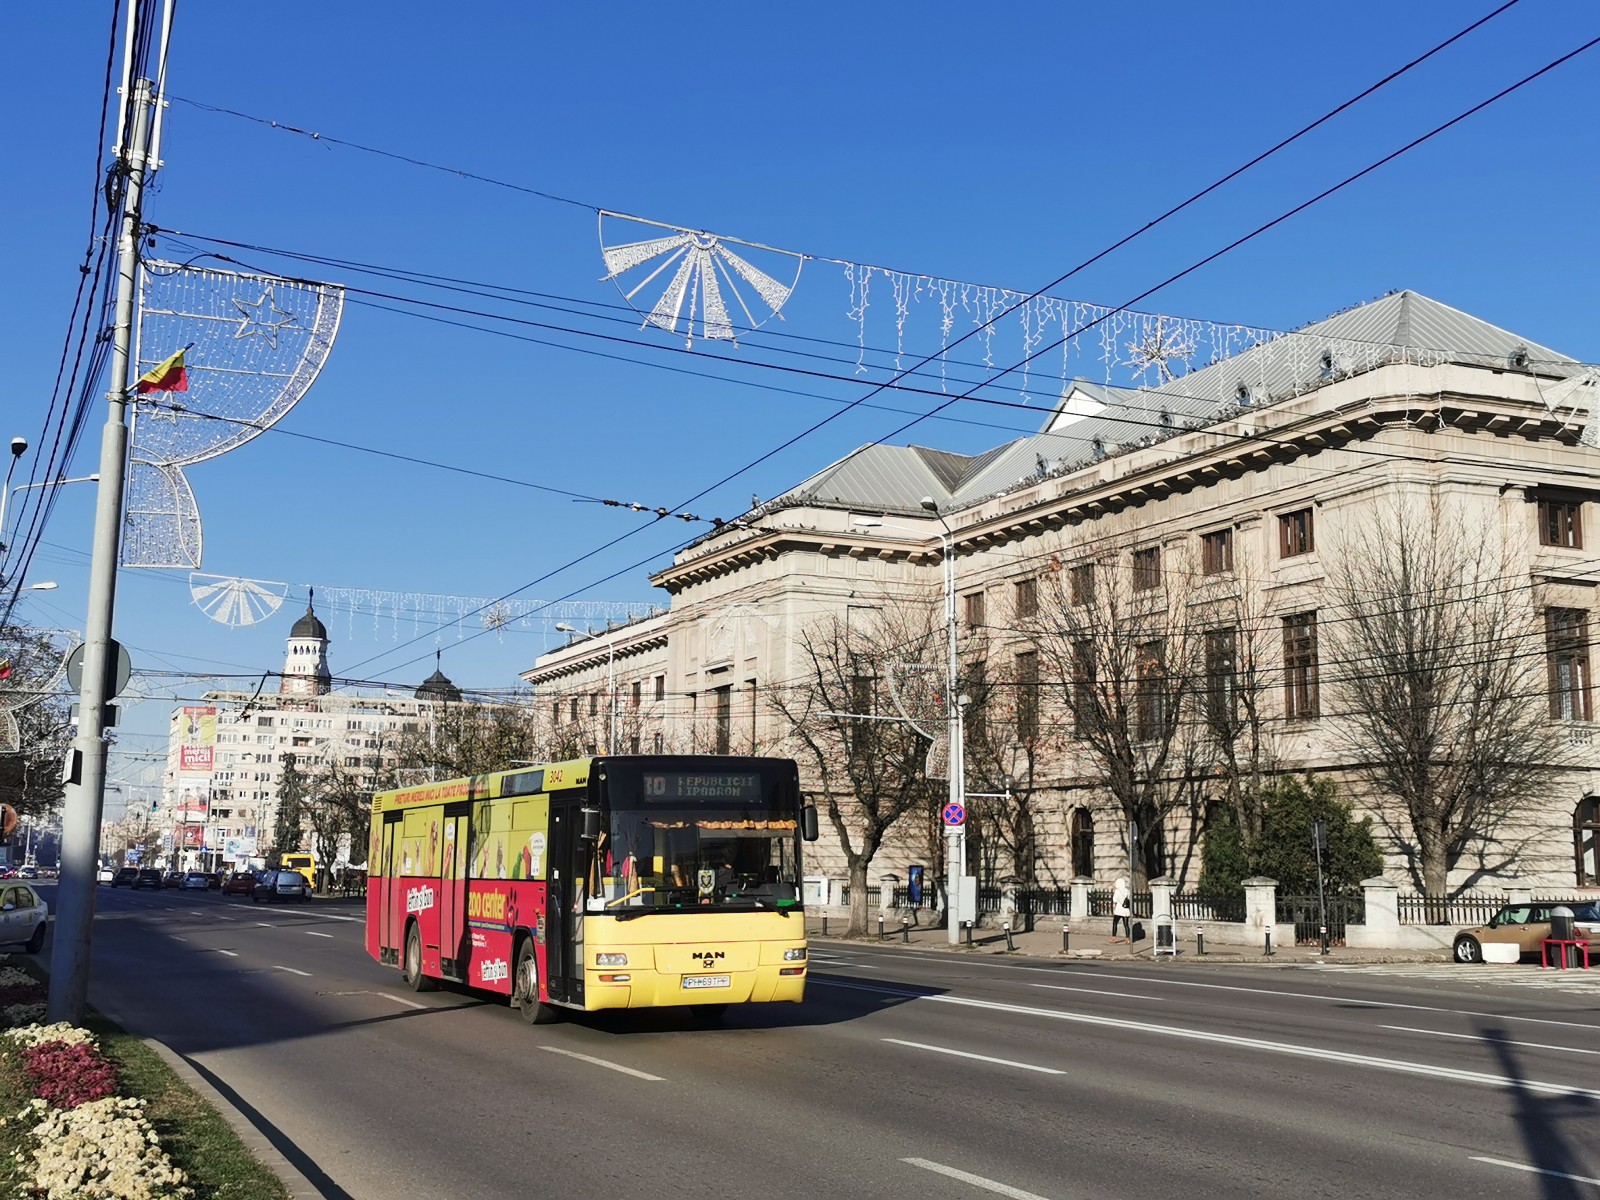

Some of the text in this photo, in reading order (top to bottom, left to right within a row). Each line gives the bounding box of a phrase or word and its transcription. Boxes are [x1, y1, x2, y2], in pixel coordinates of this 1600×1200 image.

[549, 769, 563, 783] 3042
[575, 777, 587, 785] MAN
[468, 887, 506, 920] zoo center
[692, 951, 725, 960] MAN
